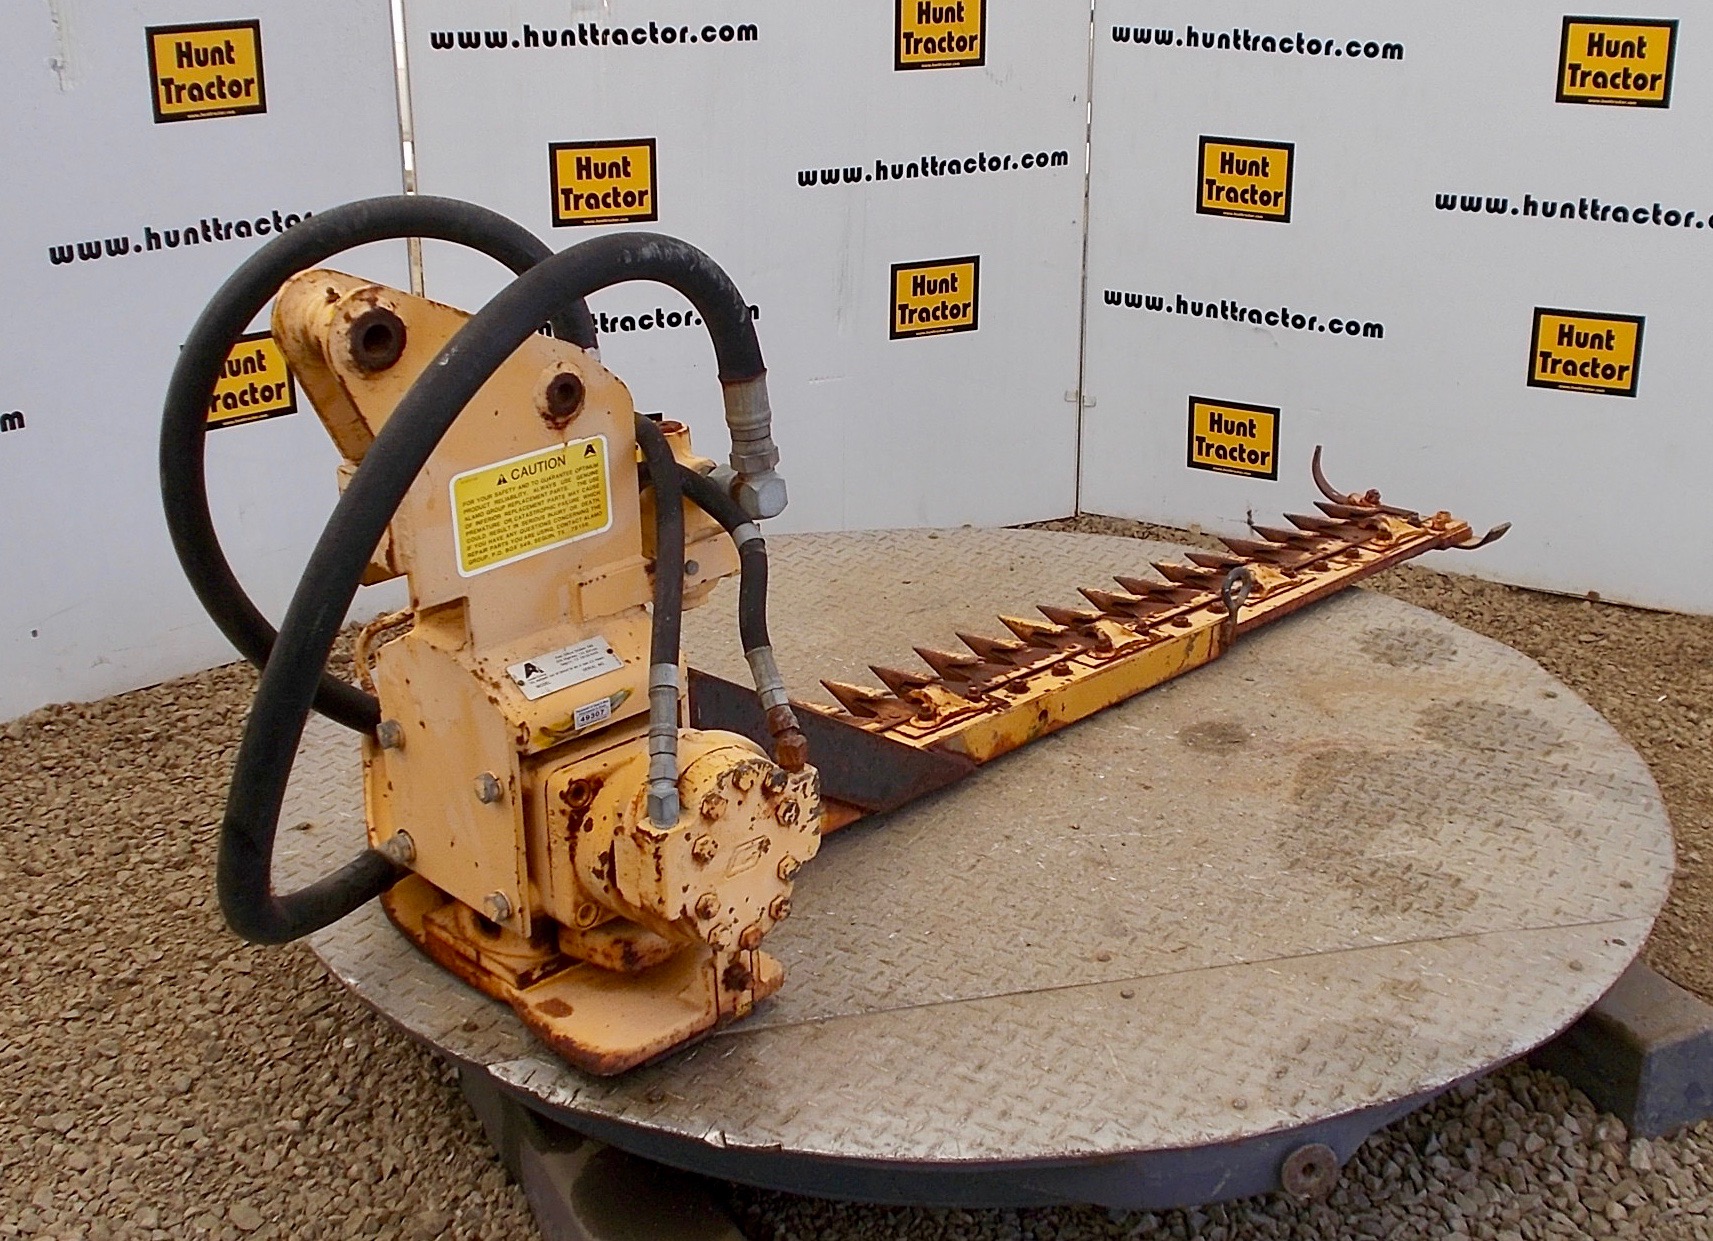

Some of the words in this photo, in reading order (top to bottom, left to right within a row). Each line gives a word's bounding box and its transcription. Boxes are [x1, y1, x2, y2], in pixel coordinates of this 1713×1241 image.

[917, 0, 965, 25] Hunt
[430, 21, 758, 50] www.hunttractor.com
[902, 30, 979, 55] Tractor
[1112, 25, 1404, 60] www.hunttractor.com
[1586, 32, 1647, 59] Hunt
[175, 39, 236, 69] Hunt
[160, 74, 255, 105] Tractor
[1567, 62, 1663, 92] Tractor
[575, 155, 632, 181] Hunt
[797, 150, 1069, 187] www.hunttractor.com
[1219, 151, 1270, 178] Hunt
[560, 186, 649, 212] Tractor
[1205, 178, 1284, 208] Tractor
[1435, 193, 1713, 229] www.hunttractor.
[48, 209, 313, 266] www.hunttracto.
[912, 272, 959, 297] Hunt
[897, 300, 972, 325] Tractor
[1104, 290, 1384, 339] www.hunttractor.com
[1557, 323, 1615, 351] Hunt
[220, 349, 267, 379] unt
[1538, 350, 1631, 382] Tractor
[210, 382, 286, 413] ractor
[1209, 411, 1257, 439] Hunt
[1195, 435, 1271, 466] Tractor
[511, 455, 566, 480] CAUTION
[580, 709, 604, 722] 49307
